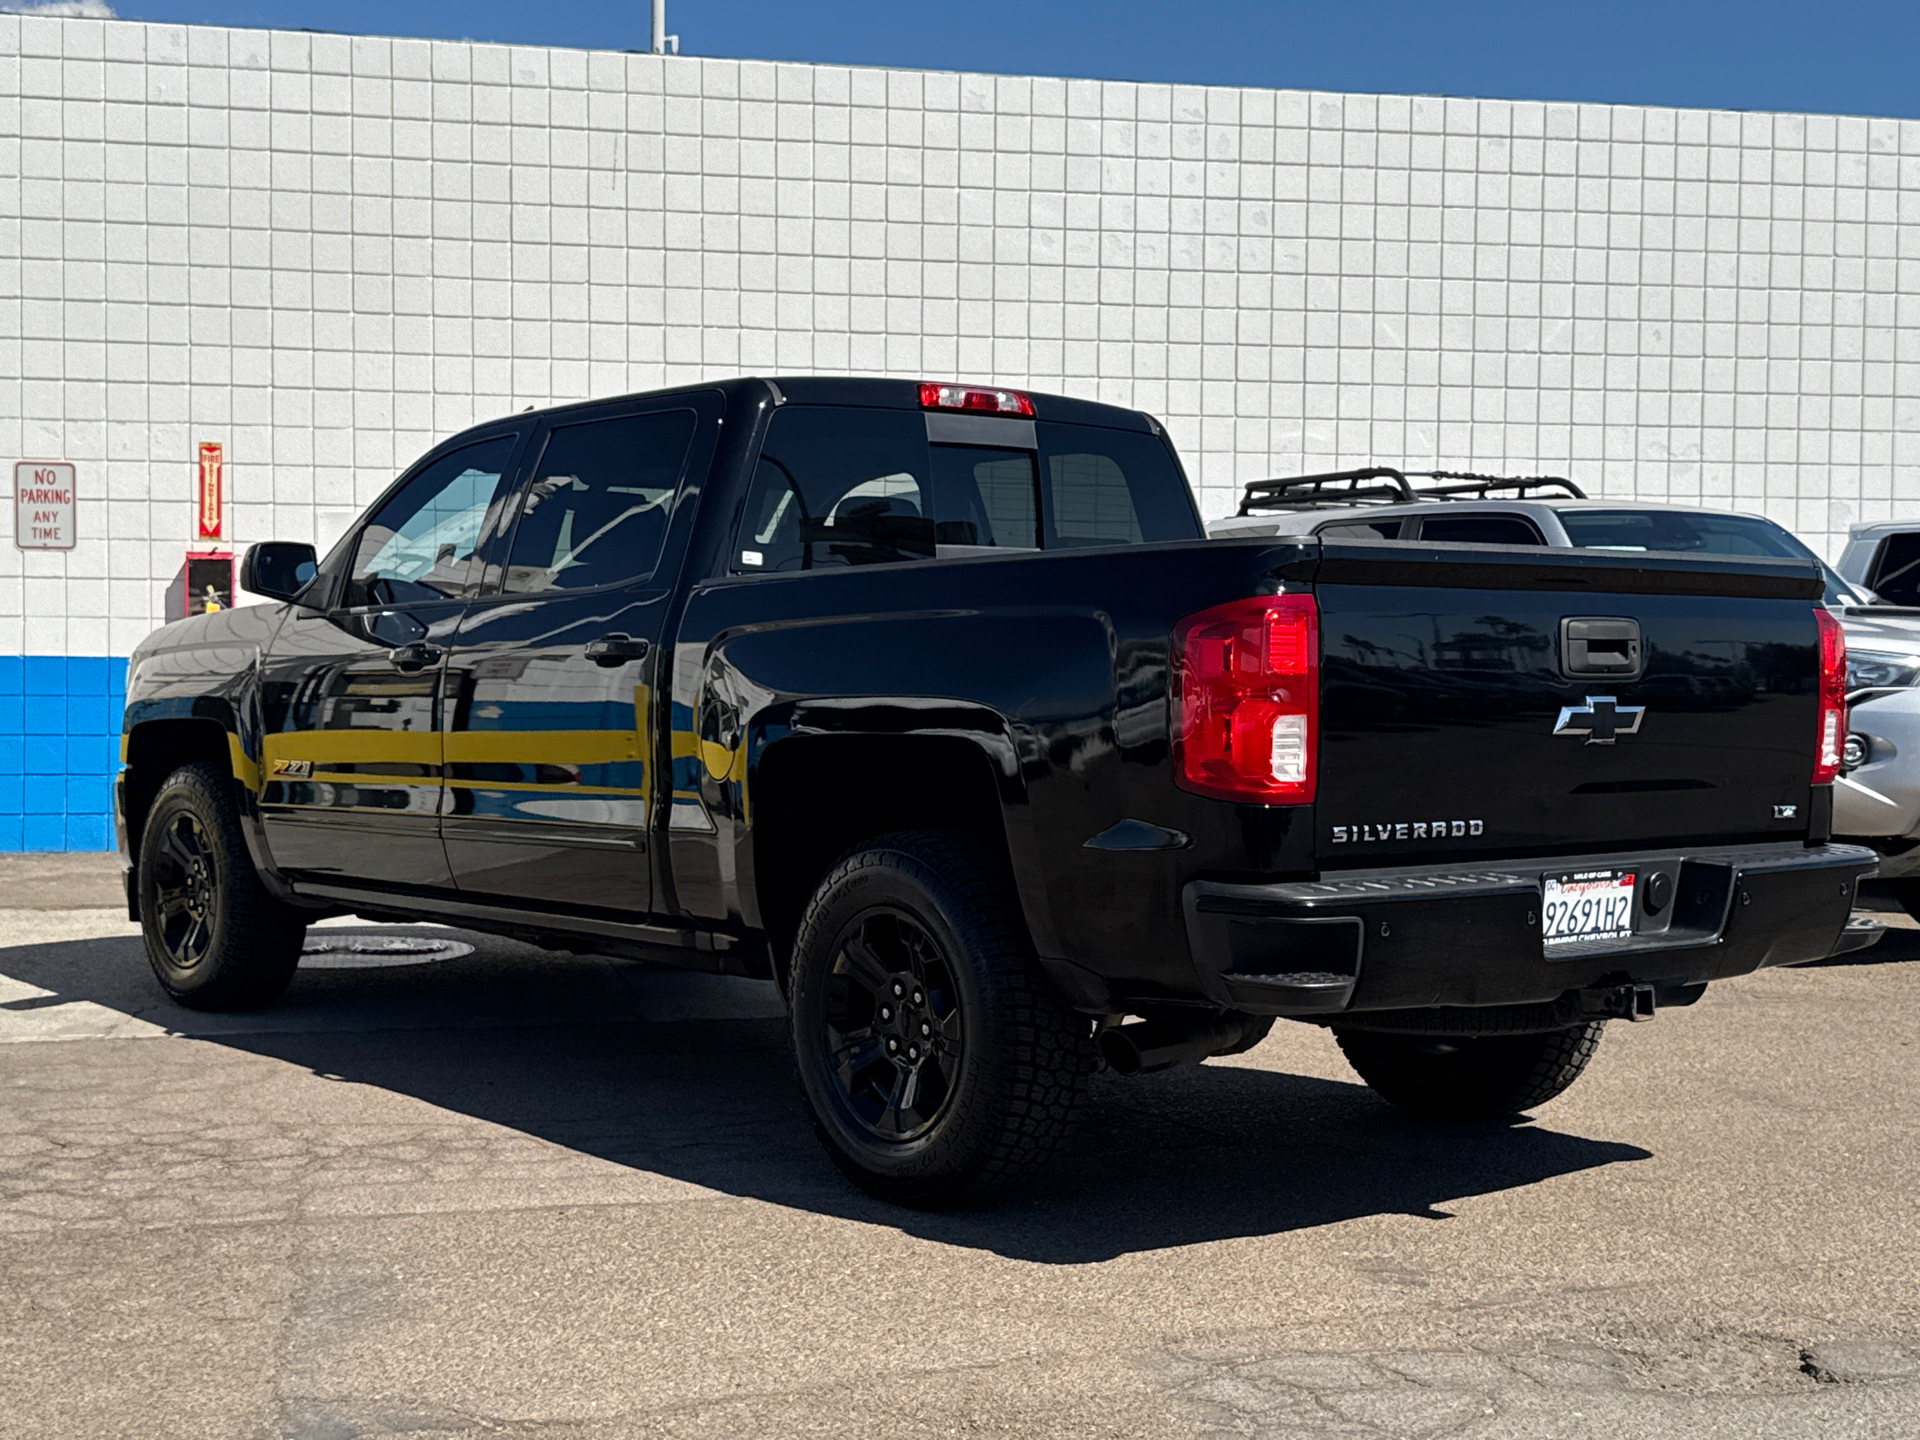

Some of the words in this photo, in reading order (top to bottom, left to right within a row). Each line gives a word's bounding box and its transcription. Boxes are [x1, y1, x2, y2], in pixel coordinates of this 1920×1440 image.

[203, 455, 220, 463] FIRE
[34, 469, 56, 486] NO
[20, 488, 71, 505] PARKING
[33, 510, 59, 523] ANY
[31, 527, 62, 541] TIME
[273, 759, 311, 778] Z71
[1332, 819, 1484, 843] SILVERADO
[1544, 896, 1628, 936] 92691H2
